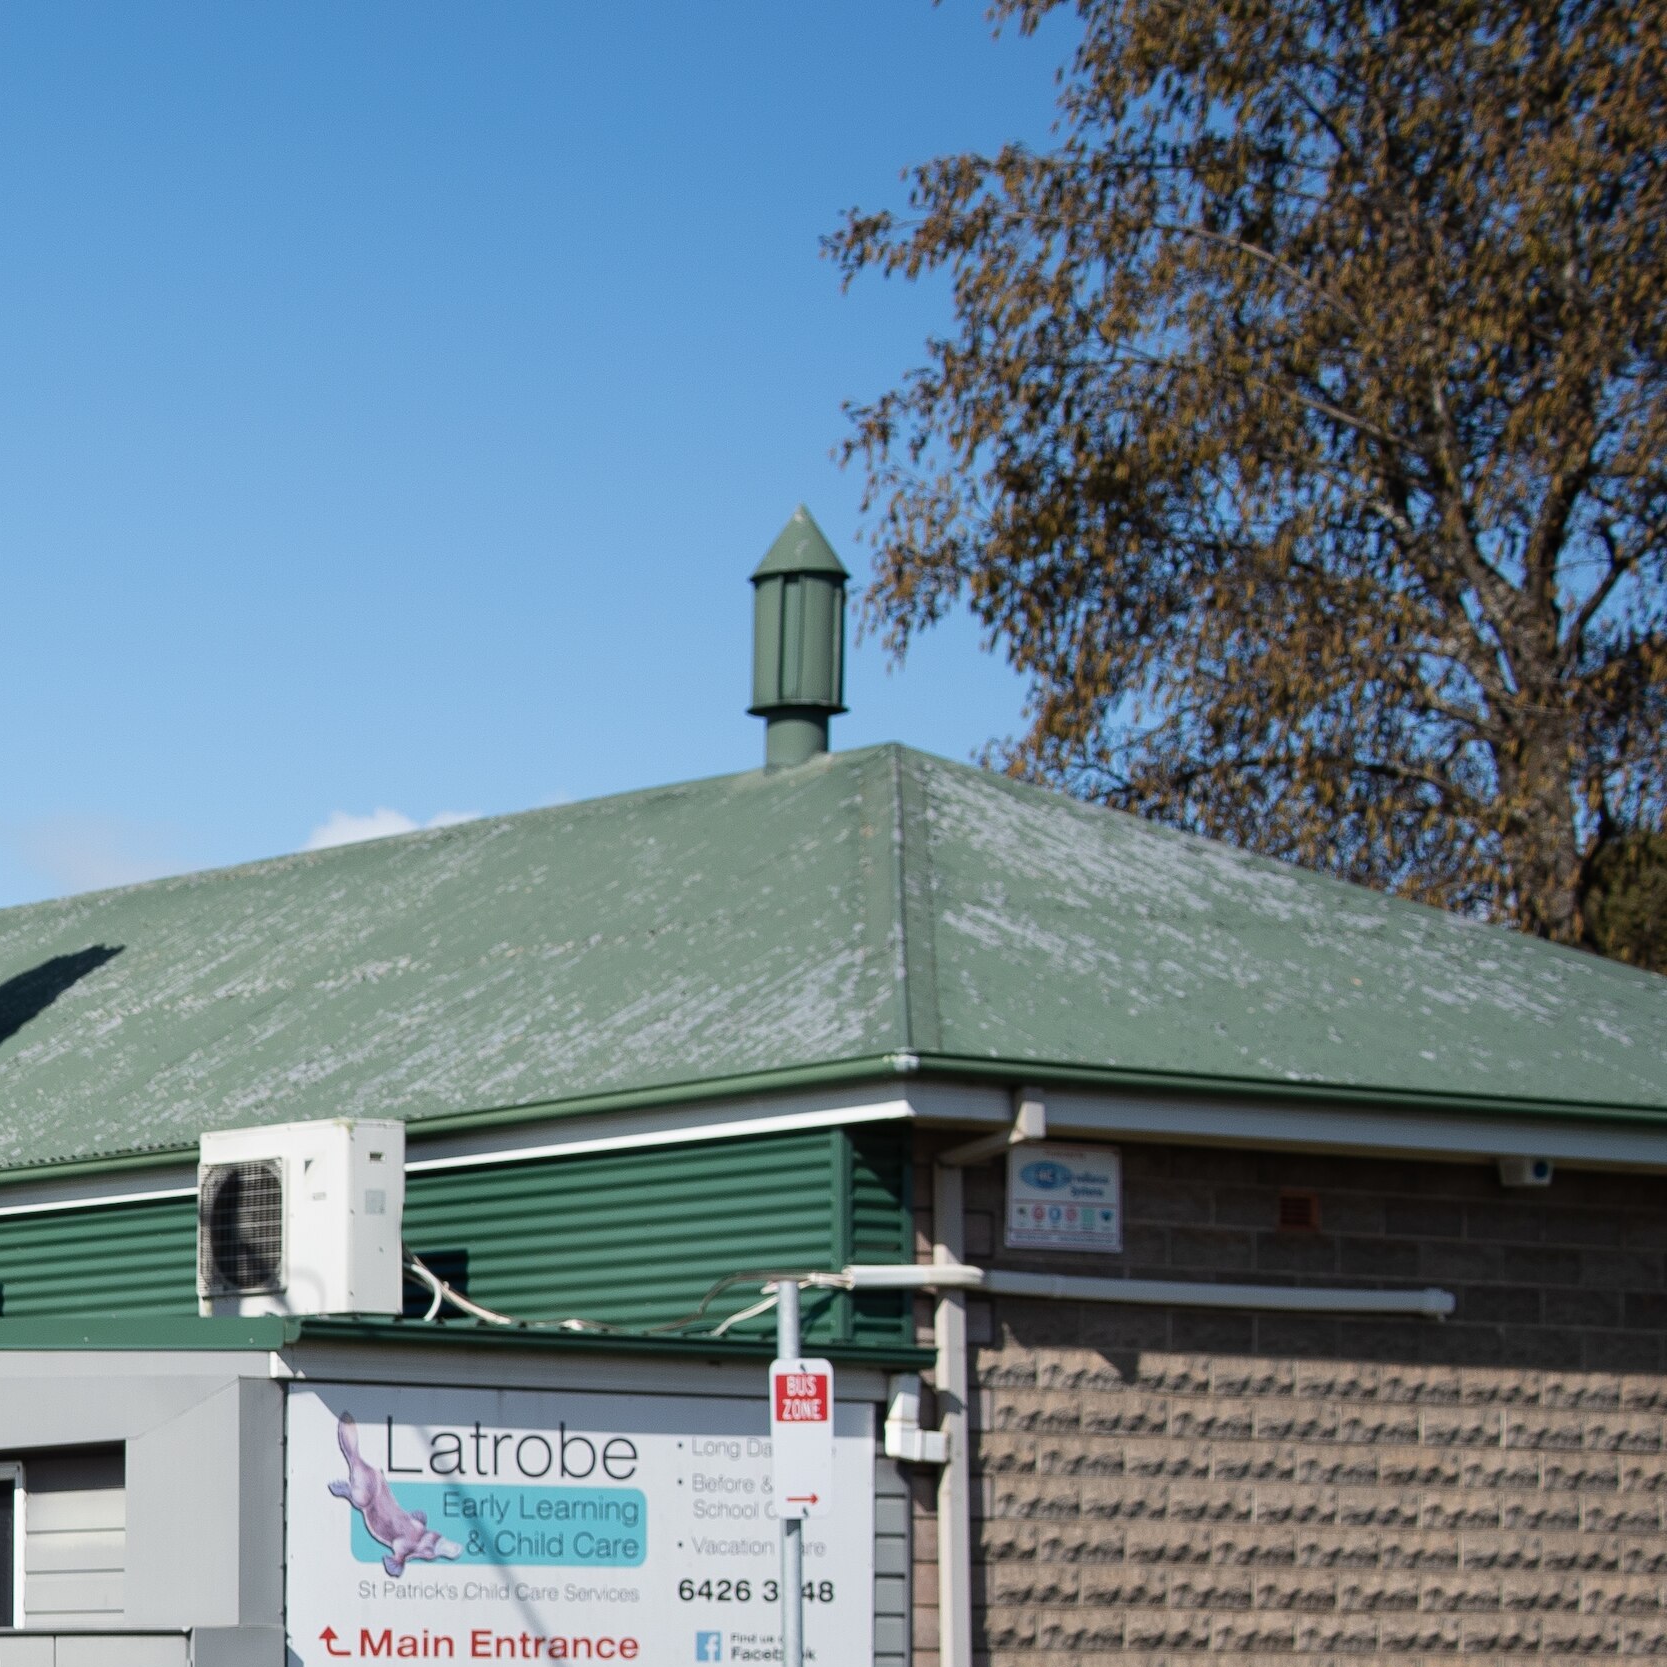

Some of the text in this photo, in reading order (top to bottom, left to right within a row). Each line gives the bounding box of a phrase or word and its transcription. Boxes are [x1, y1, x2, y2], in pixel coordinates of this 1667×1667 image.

[786, 1376, 817, 1397] BUS
[782, 1399, 822, 1420] ZONE
[387, 1415, 638, 1480] Latrobe
[691, 1437, 772, 1459] Long Da
[691, 1473, 755, 1493] Before
[443, 1491, 639, 1528] Early Learning
[692, 1499, 759, 1519] School
[466, 1530, 639, 1560] & Child Care
[691, 1537, 775, 1556] Vacation
[358, 1580, 639, 1603] St Patrick's Child Care Services
[678, 1579, 835, 1603] 6426 348
[358, 1628, 639, 1660] Main Entrance
[731, 1646, 817, 1661] Facebk
